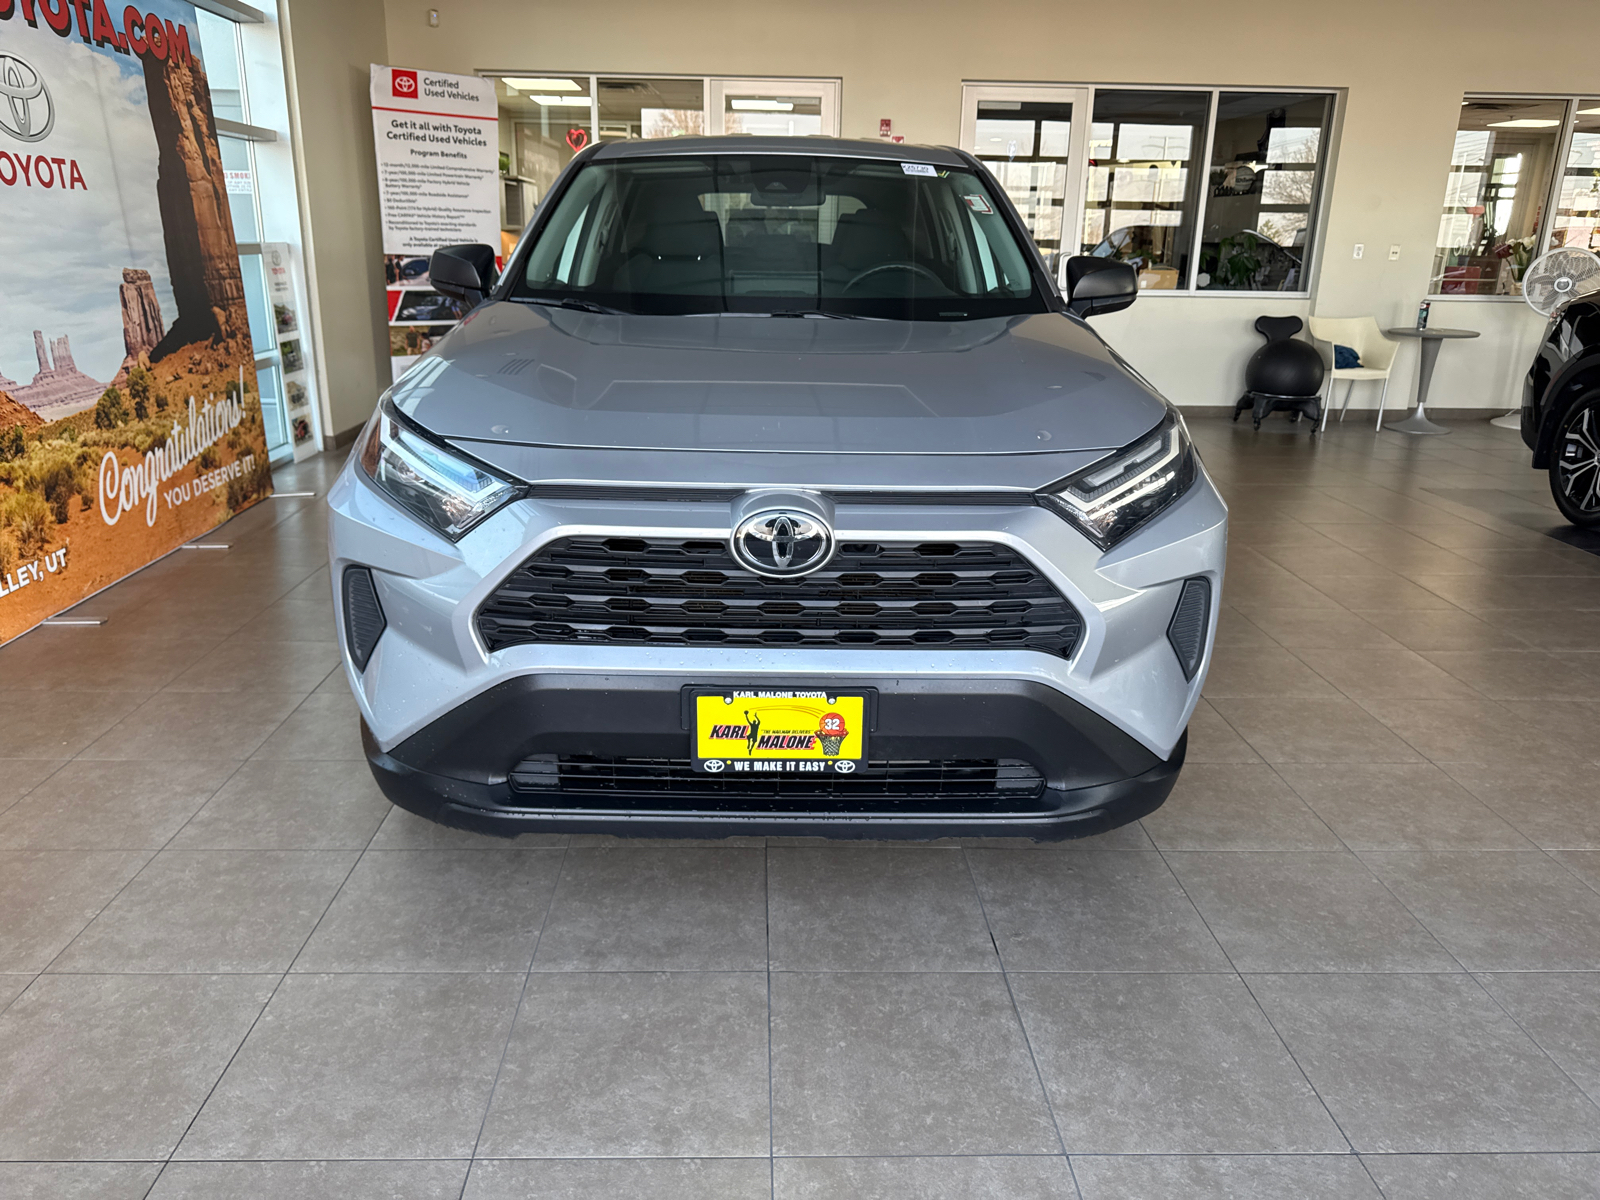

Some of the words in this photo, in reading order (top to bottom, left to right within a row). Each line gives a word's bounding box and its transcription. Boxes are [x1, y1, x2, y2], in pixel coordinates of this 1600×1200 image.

[0, 0, 193, 68] OTA.COM
[423, 77, 459, 89] Certified
[424, 88, 445, 98] Used
[447, 90, 480, 102] Vehicles
[391, 120, 408, 130] Get
[410, 121, 417, 130] it
[419, 122, 430, 132] all
[432, 123, 452, 133] with
[453, 124, 482, 136] Toyota
[386, 131, 427, 142] Certified
[428, 134, 451, 144] Used
[452, 135, 488, 147] Vehicles
[410, 148, 440, 158] Program
[440, 151, 468, 160] Benefits
[99, 365, 246, 527] Congratulations!
[164, 482, 191, 509] YOU
[193, 461, 242, 496] DESERVE
[242, 453, 256, 475] IT!
[45, 548, 66, 572] UT
[824, 718, 840, 730] 32
[709, 725, 749, 740] KARL
[756, 735, 817, 750] MALONE
[734, 762, 750, 771] WE
[754, 762, 782, 771] MAKE
[786, 762, 796, 771] IT
[799, 762, 826, 771] EASY
